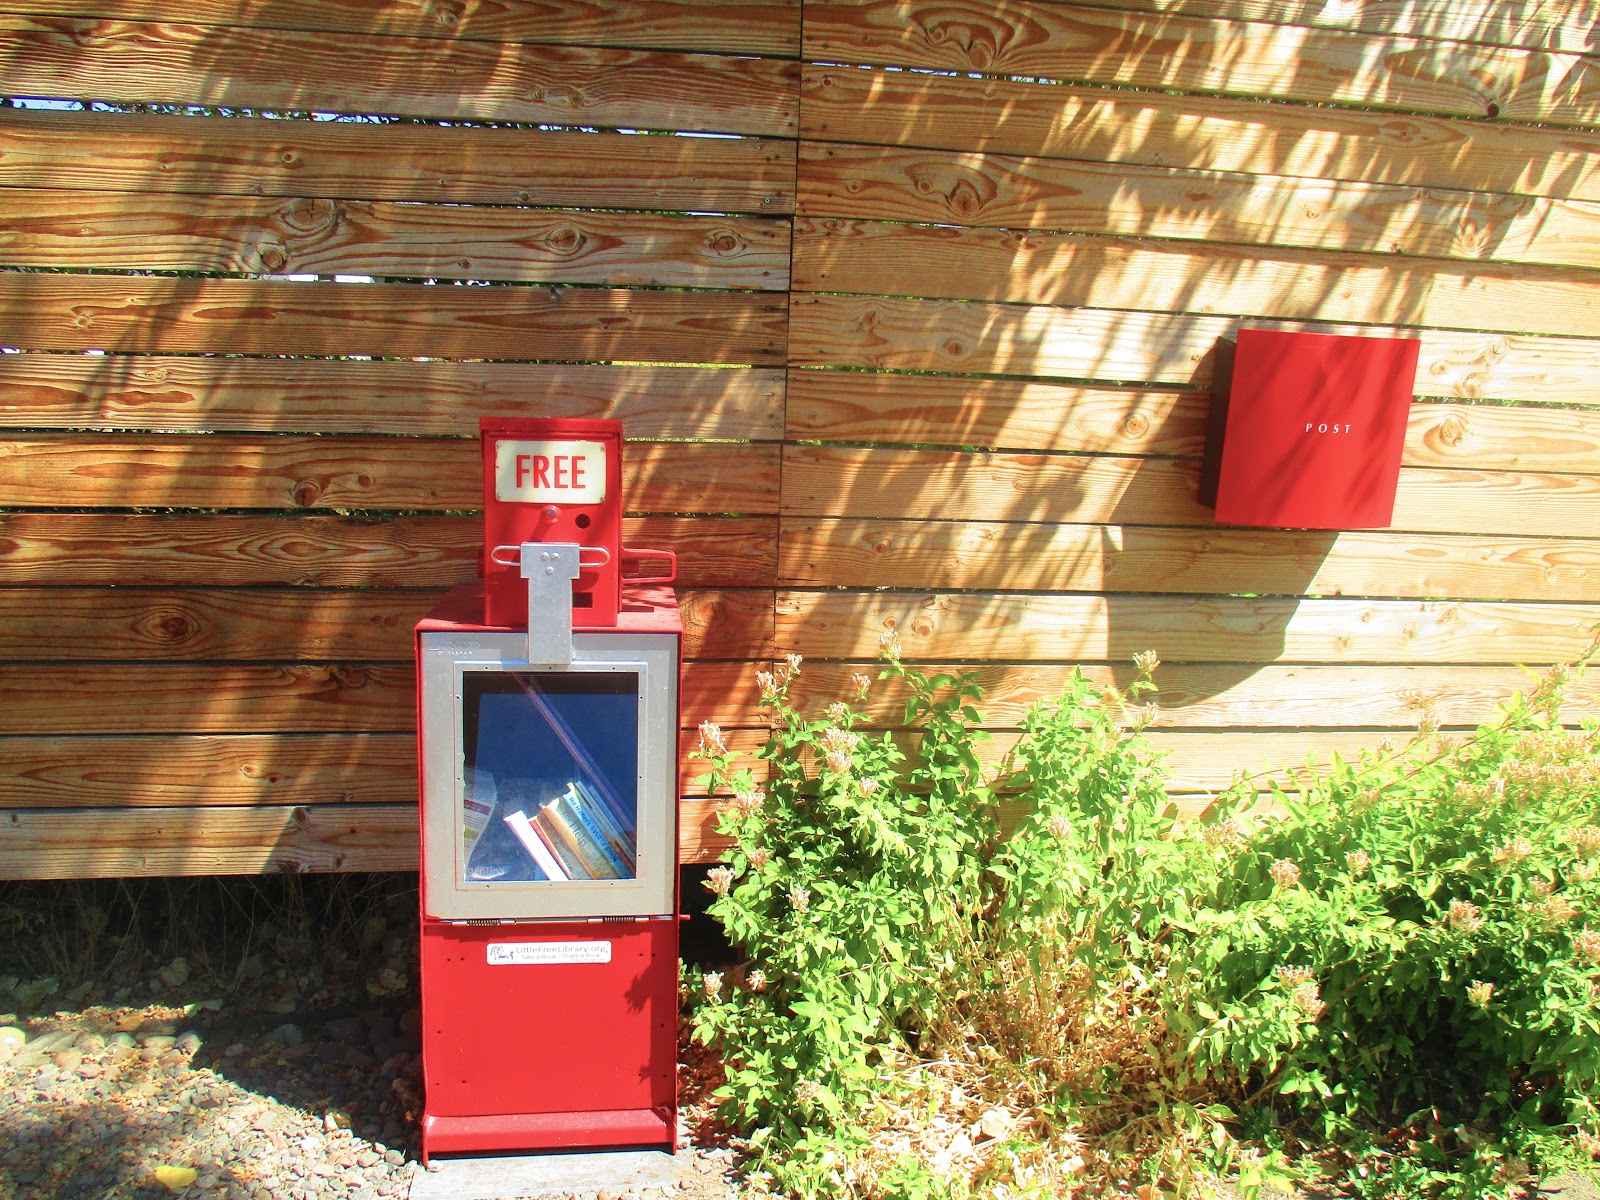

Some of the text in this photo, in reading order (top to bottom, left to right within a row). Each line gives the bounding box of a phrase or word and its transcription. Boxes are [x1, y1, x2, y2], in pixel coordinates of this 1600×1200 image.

[1305, 423, 1351, 434] POST
[516, 454, 586, 489] FREE
[569, 822, 587, 847] Help
[604, 846, 617, 863] BOOK
[515, 945, 606, 954] LittleFreeLibrary.org
